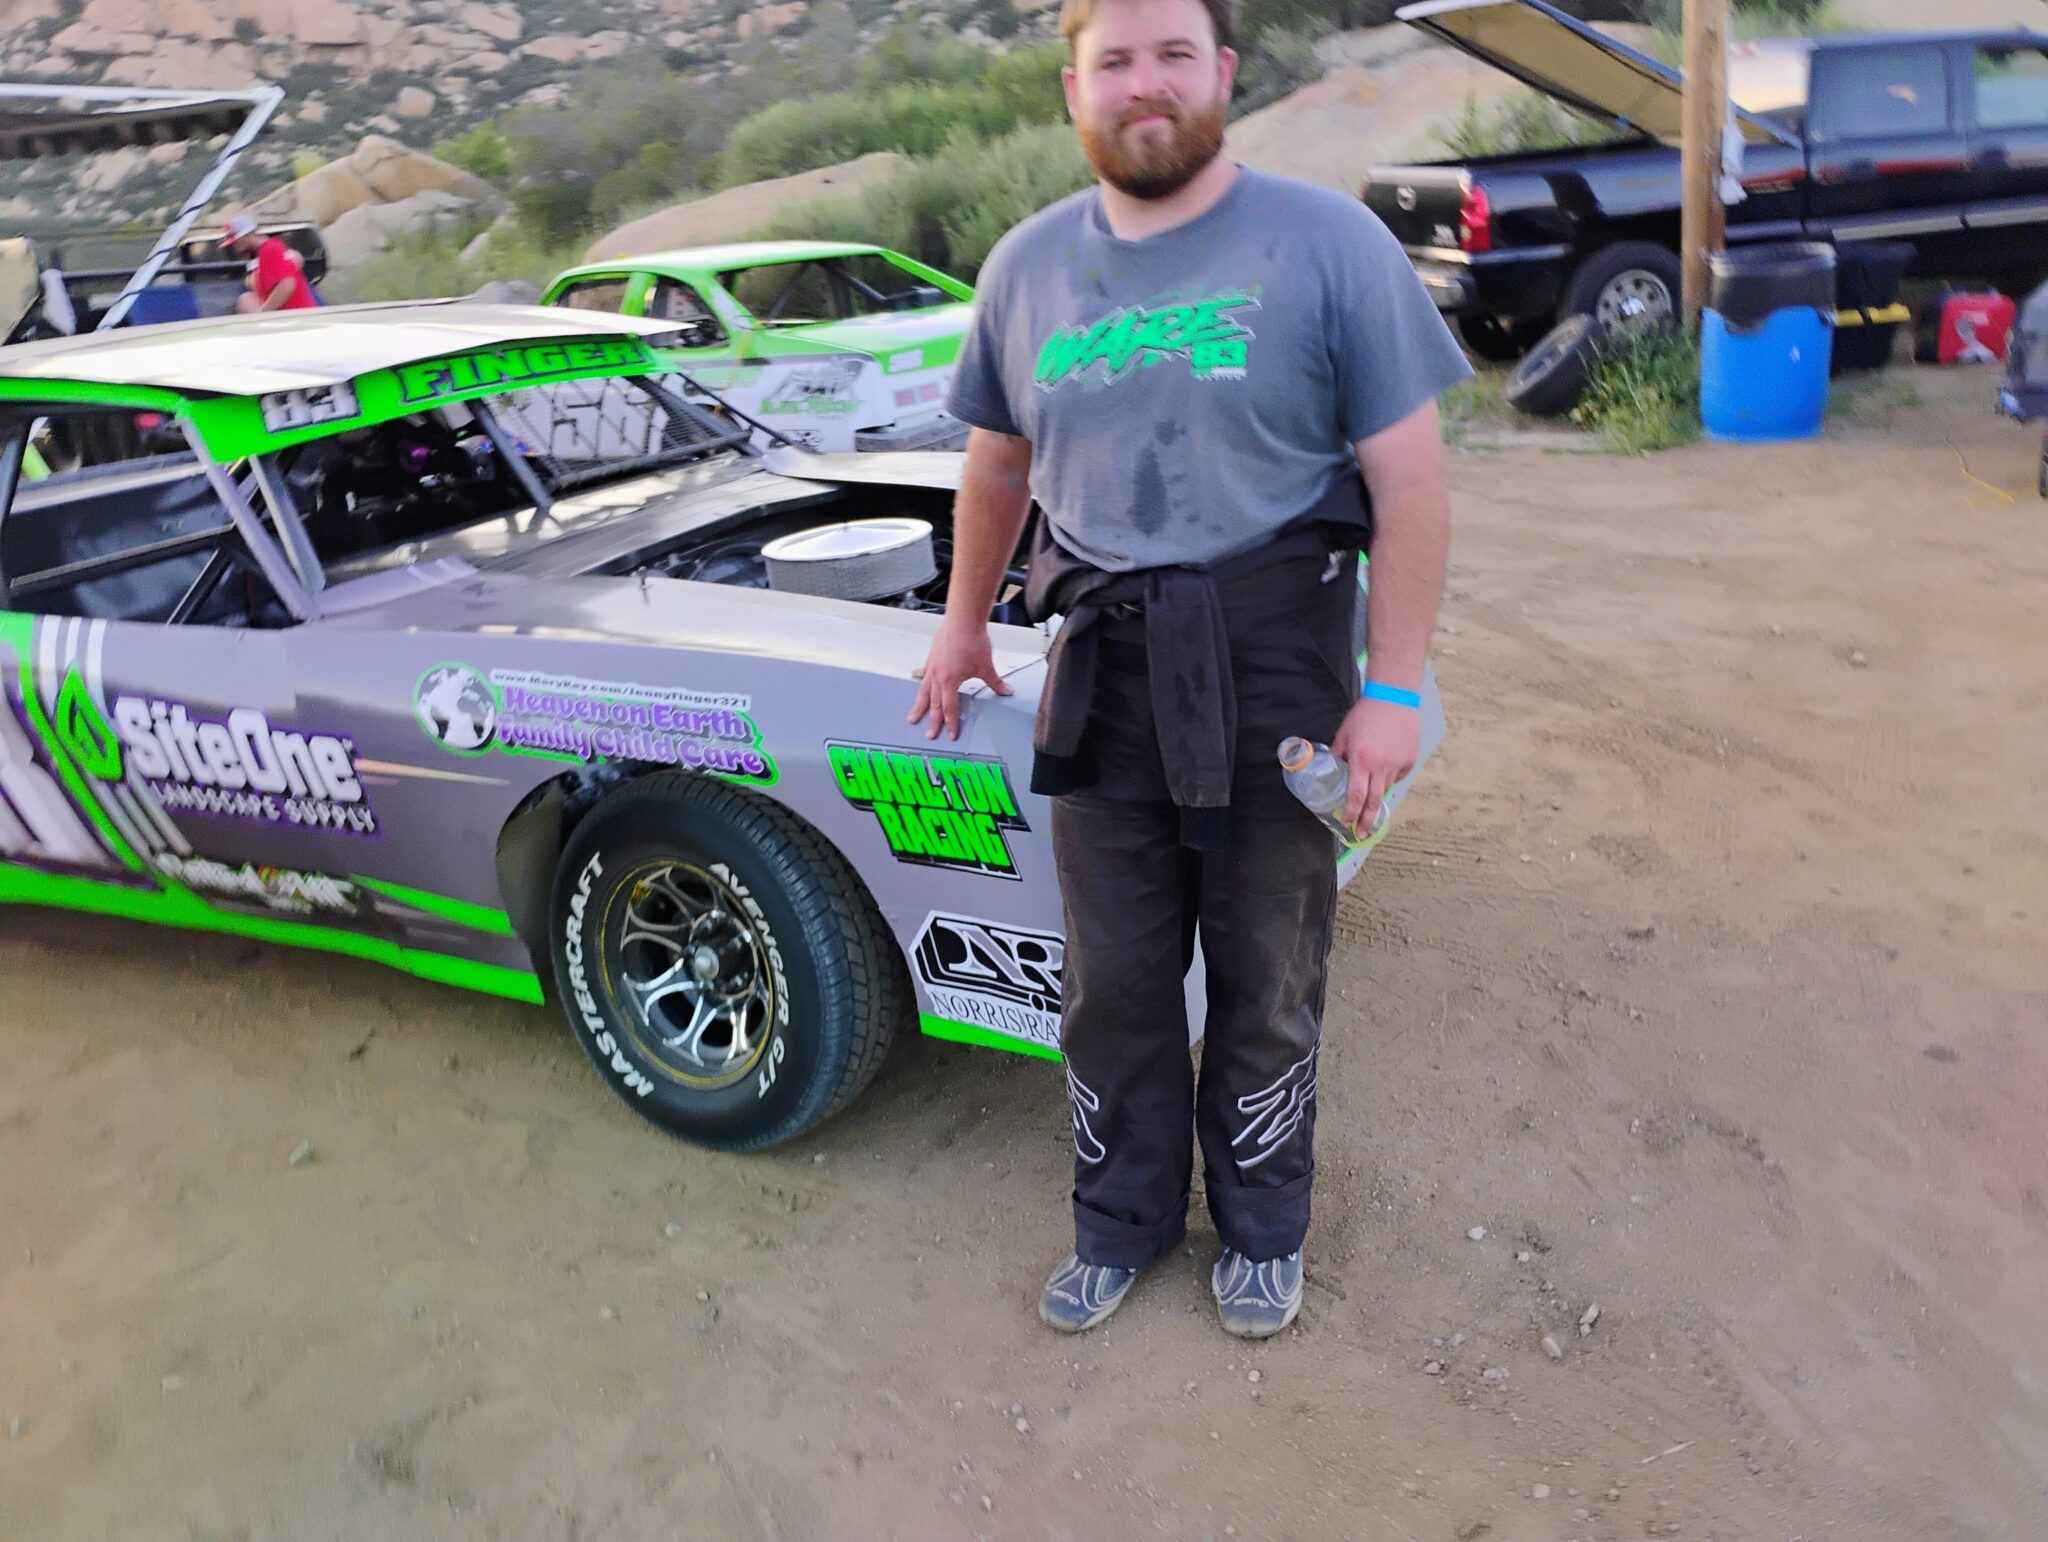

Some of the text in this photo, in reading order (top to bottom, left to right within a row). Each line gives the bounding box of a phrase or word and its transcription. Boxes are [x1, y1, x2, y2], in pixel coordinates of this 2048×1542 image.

[1034, 294, 1262, 393] WARE
[261, 340, 648, 432] 83 FINGER
[498, 715, 764, 773] Family Child Care
[504, 686, 747, 739] Heaven on Earth
[114, 696, 362, 802] SiteOne
[828, 745, 1018, 817] CHARLTON
[151, 780, 376, 833] LANDSCAPE SUPPLY
[872, 801, 1012, 867] RACING
[565, 851, 655, 1098] MASTERCRAFT
[709, 862, 790, 1026] AVENGER
[931, 991, 1022, 1034] NORRIS
